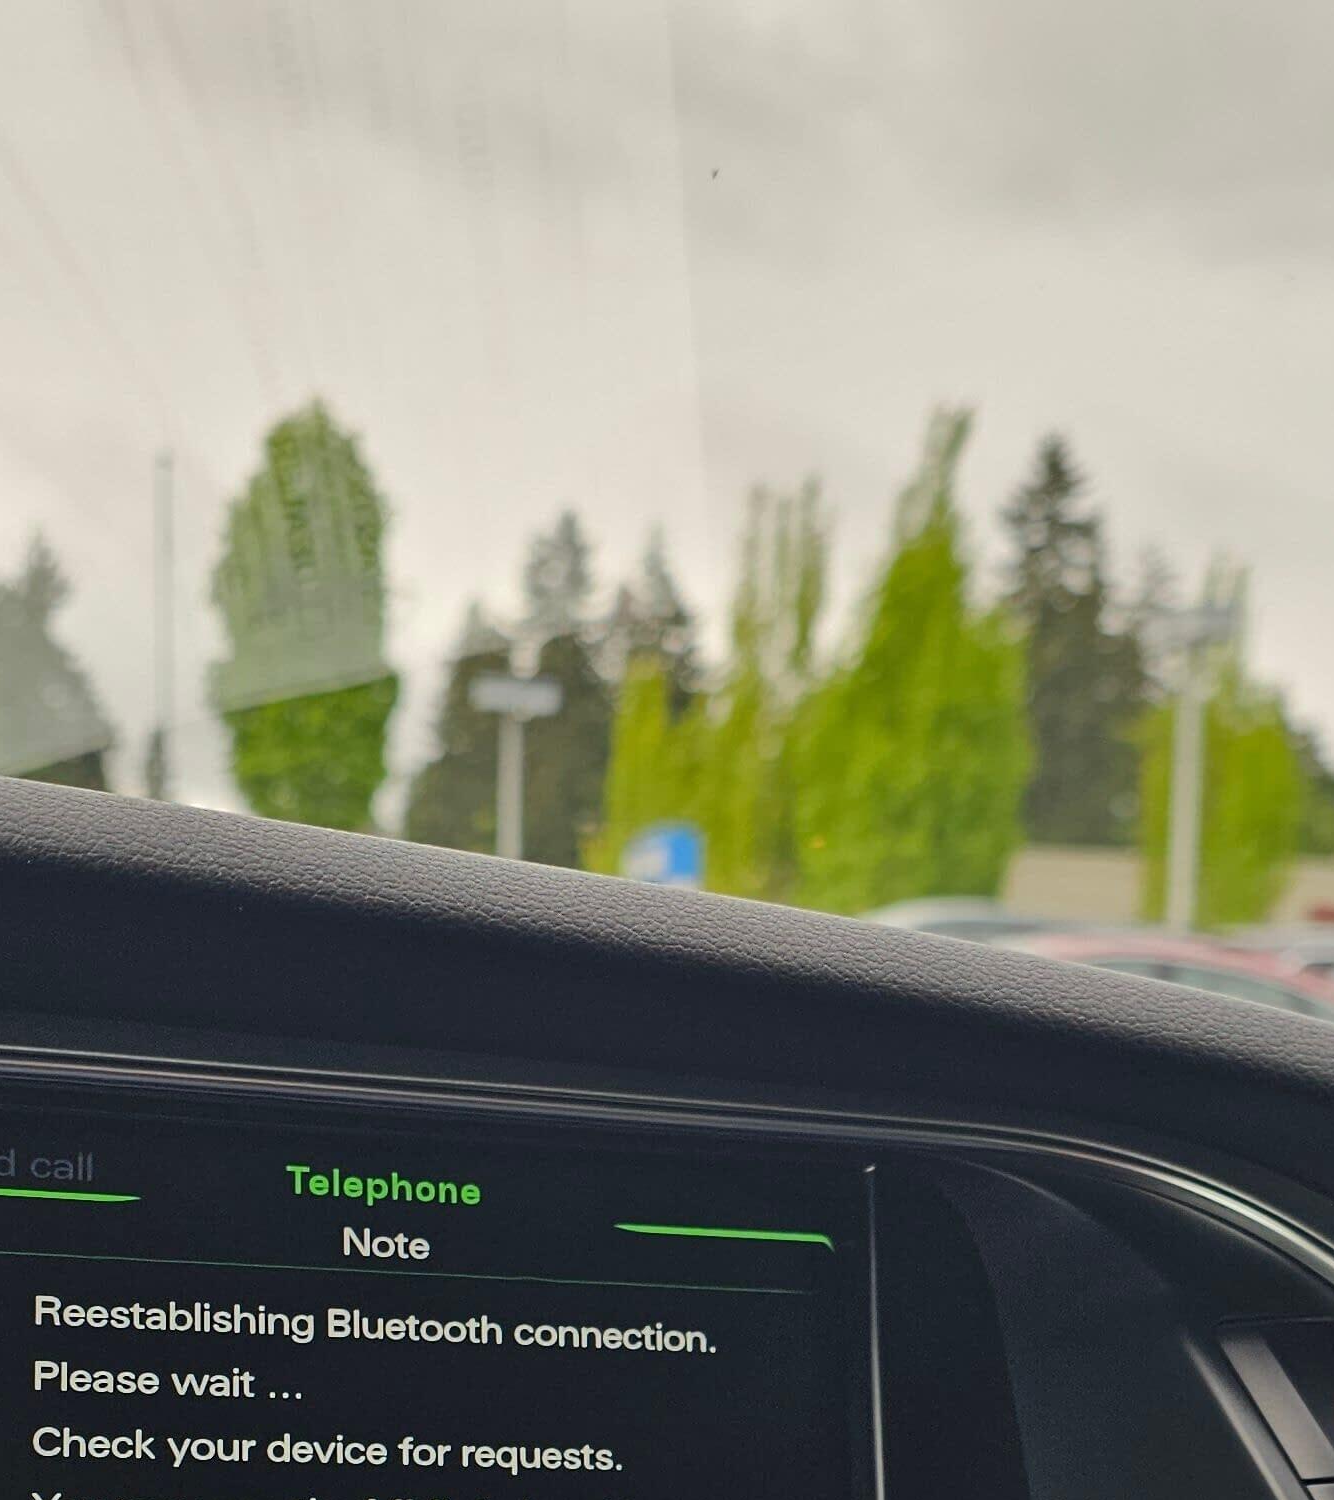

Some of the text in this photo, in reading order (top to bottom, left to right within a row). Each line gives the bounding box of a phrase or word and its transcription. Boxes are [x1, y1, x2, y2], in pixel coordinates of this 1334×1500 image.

[30, 1152, 94, 1182] call
[285, 1165, 481, 1207] Telephone
[343, 1226, 431, 1260] Note
[35, 1295, 717, 1354] Reestablishing Bluetooth connection.
[34, 1360, 160, 1395] Please
[170, 1367, 256, 1398] wait
[32, 1426, 623, 1476] Check your device for requests.
